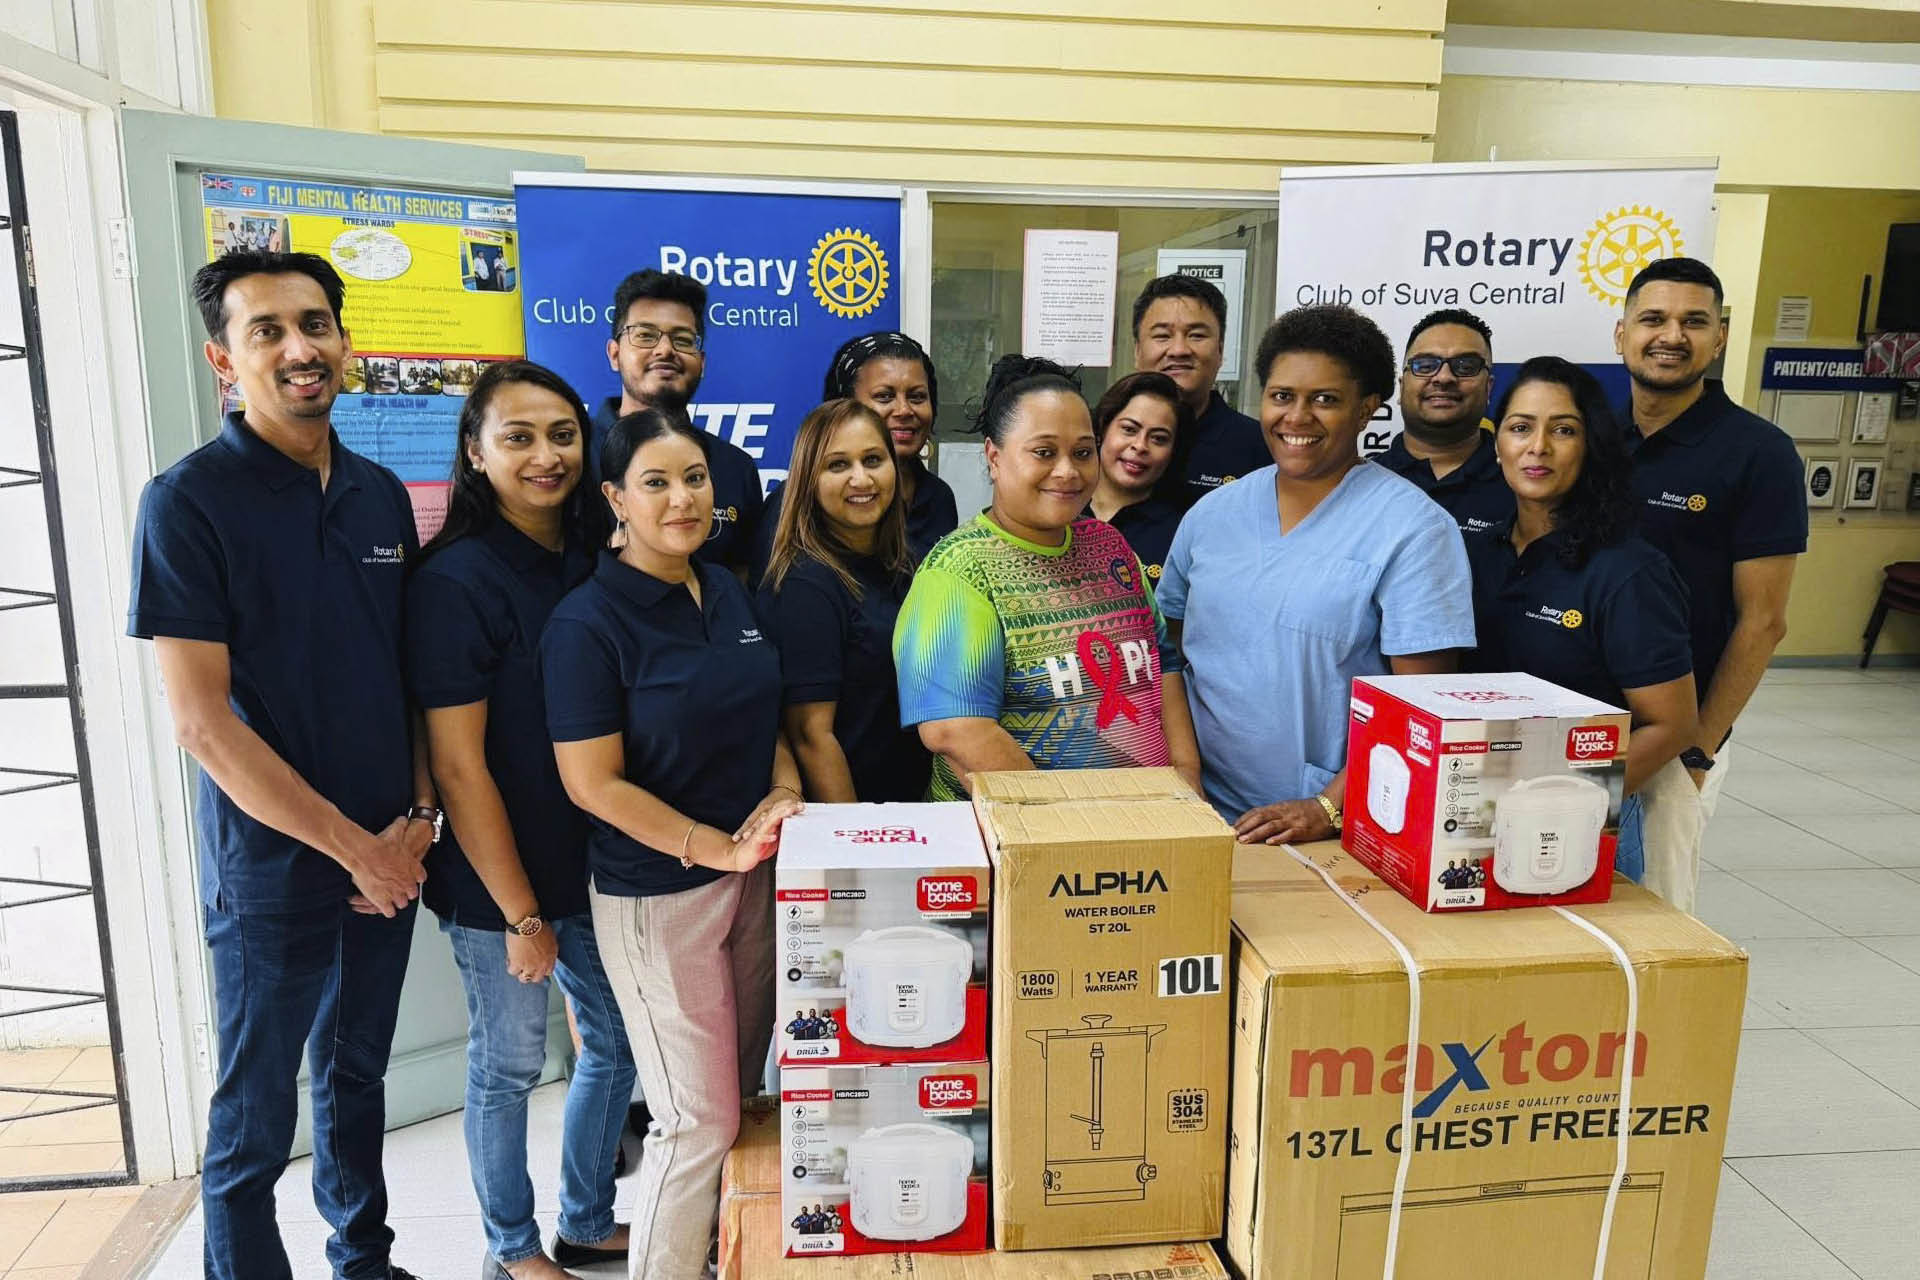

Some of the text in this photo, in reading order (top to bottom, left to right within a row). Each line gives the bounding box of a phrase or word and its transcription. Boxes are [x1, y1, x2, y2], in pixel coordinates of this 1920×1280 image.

[268, 185, 293, 205] FIJI
[296, 188, 349, 210] MENTAL
[352, 191, 401, 214] HEALTH
[405, 197, 463, 219] SERVICES
[342, 217, 395, 228] STRESS WARDS
[1423, 230, 1574, 276] Rotary
[660, 245, 798, 296] Rotary
[1180, 267, 1220, 278] NOTICE
[1297, 282, 1565, 306] Club of Suva Central
[533, 297, 596, 324] Club
[708, 302, 799, 328] Central
[1773, 360, 1863, 377] PATIENT/CARE
[1661, 491, 1688, 505] Rotary
[373, 545, 397, 558] Rotary
[1571, 729, 1608, 743] home
[1576, 739, 1615, 752] basics
[833, 827, 915, 842] basics
[850, 836, 928, 845] home
[921, 879, 963, 895] home
[1049, 870, 1169, 898] ALPHA
[785, 891, 825, 899] Rice Cooker
[927, 889, 973, 904] basics
[1064, 904, 1157, 919] WATER BOILER
[1088, 922, 1132, 934] ST 20L
[1020, 973, 1055, 987] 1800
[1085, 970, 1138, 984] 1 YEAR
[1160, 956, 1220, 996] 10L
[1021, 986, 1054, 997] Watts
[1084, 982, 1138, 993] WARRANTY
[1288, 1019, 1649, 1118] maxton
[923, 1077, 964, 1091] home
[929, 1086, 973, 1100] basics
[1172, 1094, 1204, 1107] SUS
[1453, 1099, 1511, 1115] BECAUSE
[1518, 1095, 1571, 1109] QUALITY
[1172, 1105, 1204, 1118] 304
[1286, 1104, 1710, 1160] 137L CHEST FREEZER
